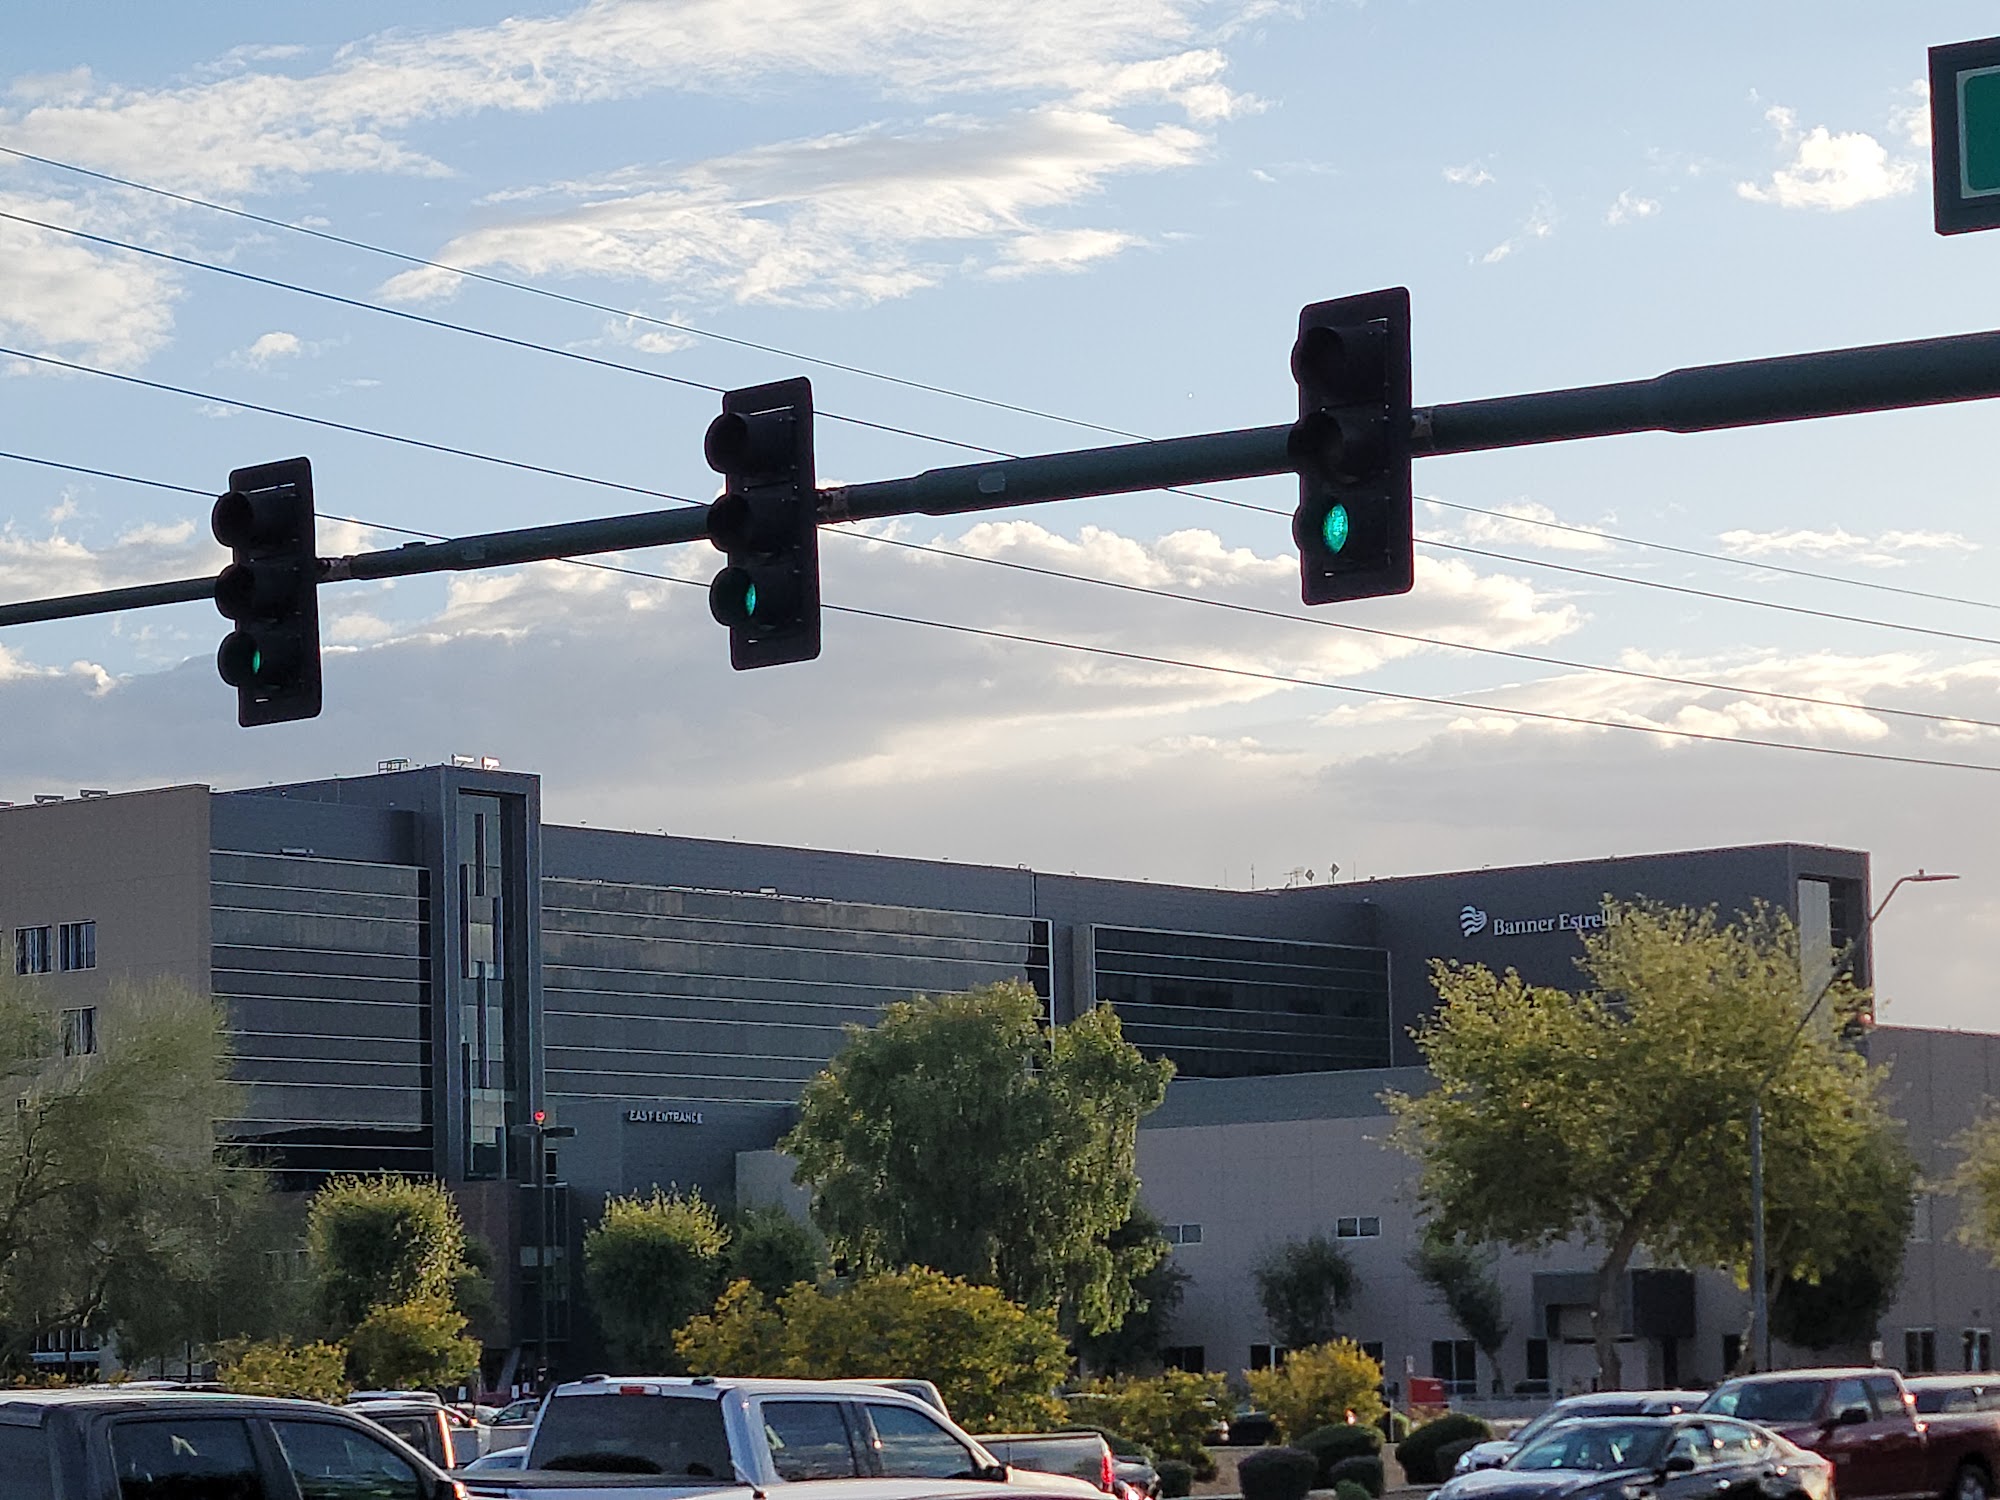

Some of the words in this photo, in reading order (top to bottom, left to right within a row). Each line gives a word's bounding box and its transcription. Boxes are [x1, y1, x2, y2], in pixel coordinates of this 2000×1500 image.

[1493, 918, 1555, 935] Banner
[629, 1110, 653, 1121] EAST
[655, 1111, 703, 1124] ENTRANCE
